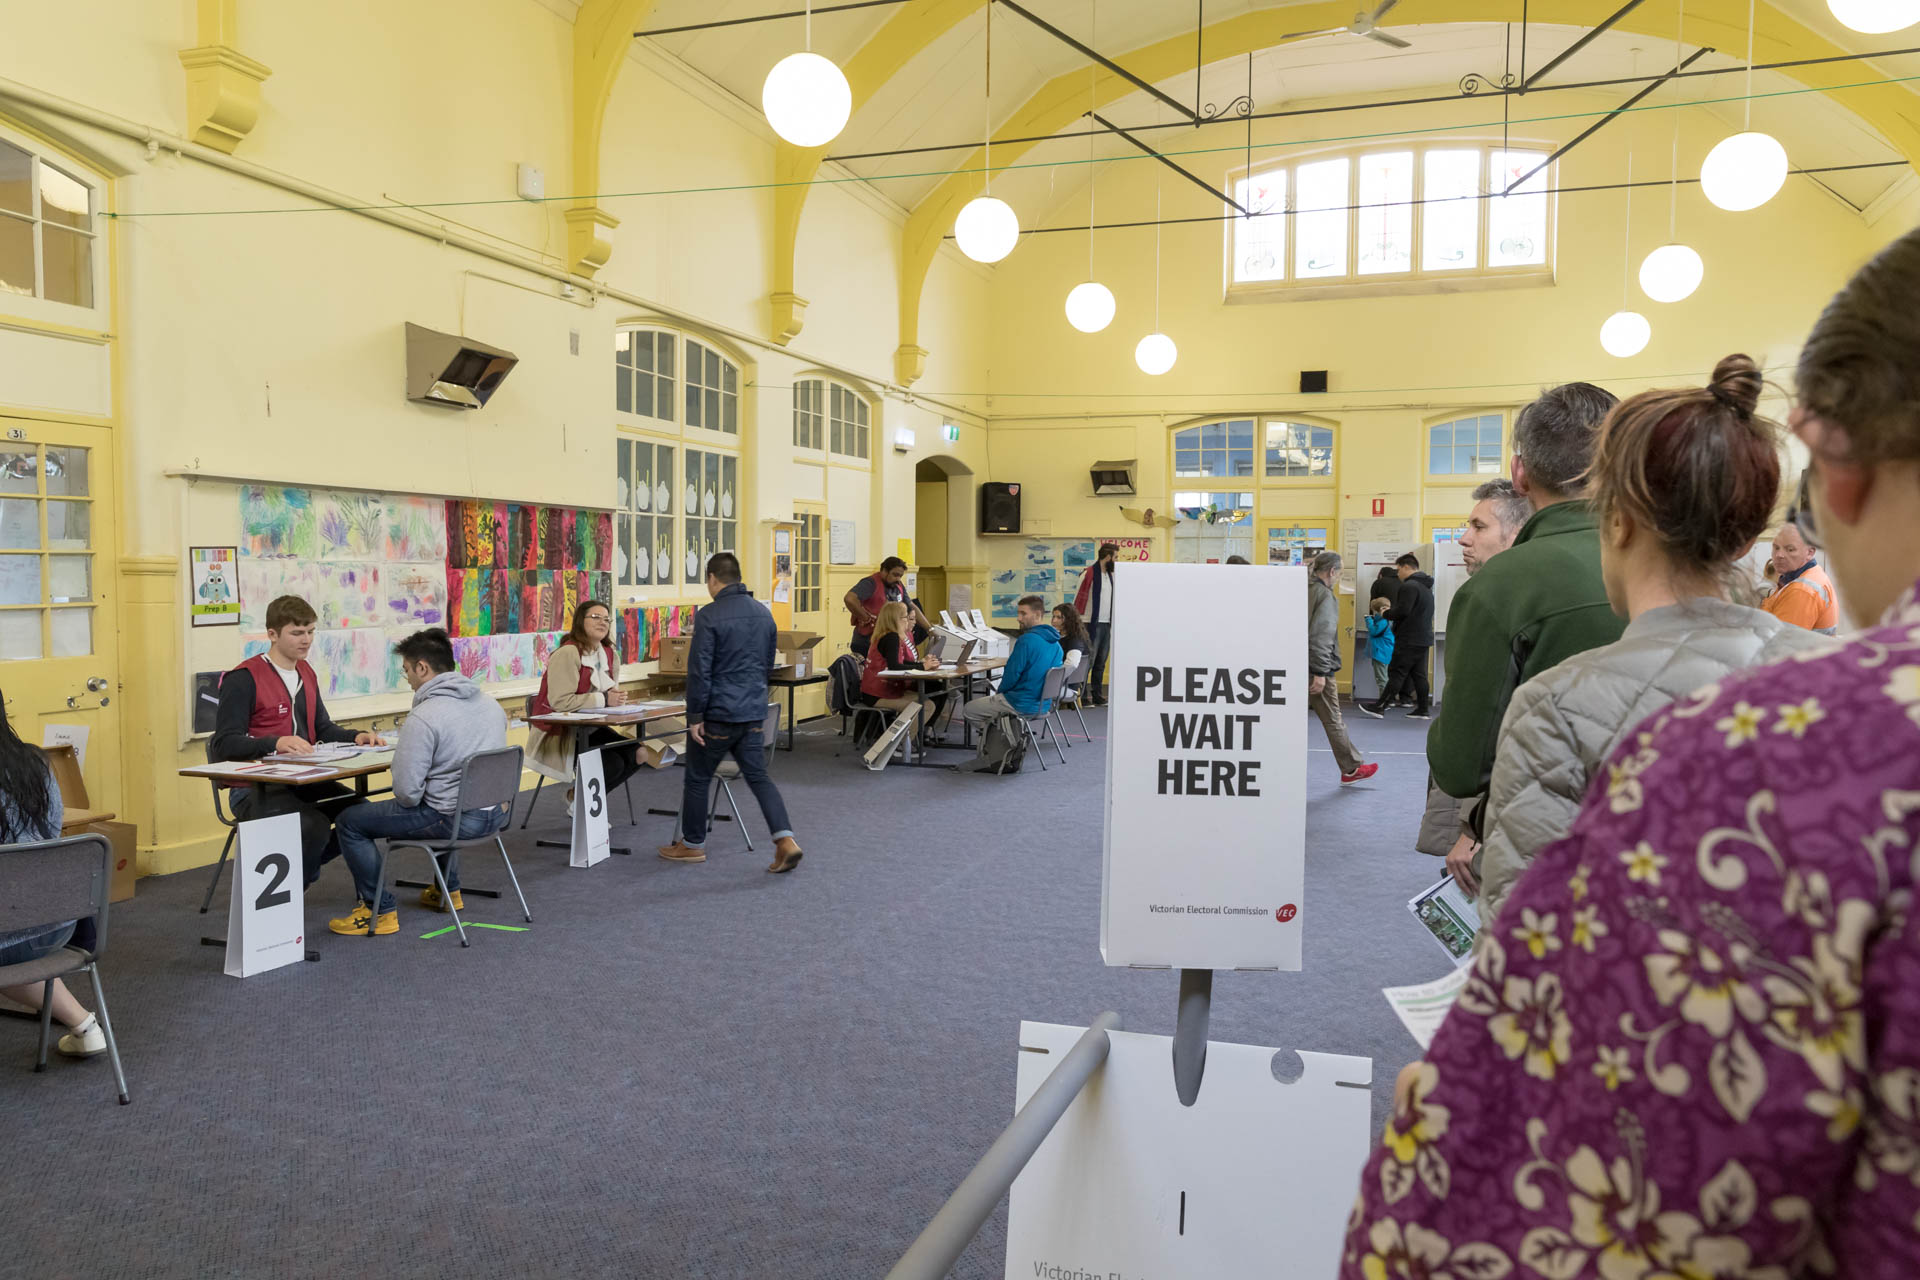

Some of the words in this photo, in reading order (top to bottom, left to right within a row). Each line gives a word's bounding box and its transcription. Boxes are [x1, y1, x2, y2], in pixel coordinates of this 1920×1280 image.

[13, 430, 22, 438] 31
[1136, 666, 1287, 706] PLEASE
[1160, 713, 1261, 751] WAIT
[588, 777, 602, 817] 3
[1158, 759, 1261, 797] HERE
[255, 852, 290, 911] 2
[1149, 904, 1185, 913] Victorian
[1187, 905, 1221, 915] Electoral
[1223, 906, 1268, 916] Commission
[1276, 908, 1295, 918] VEC
